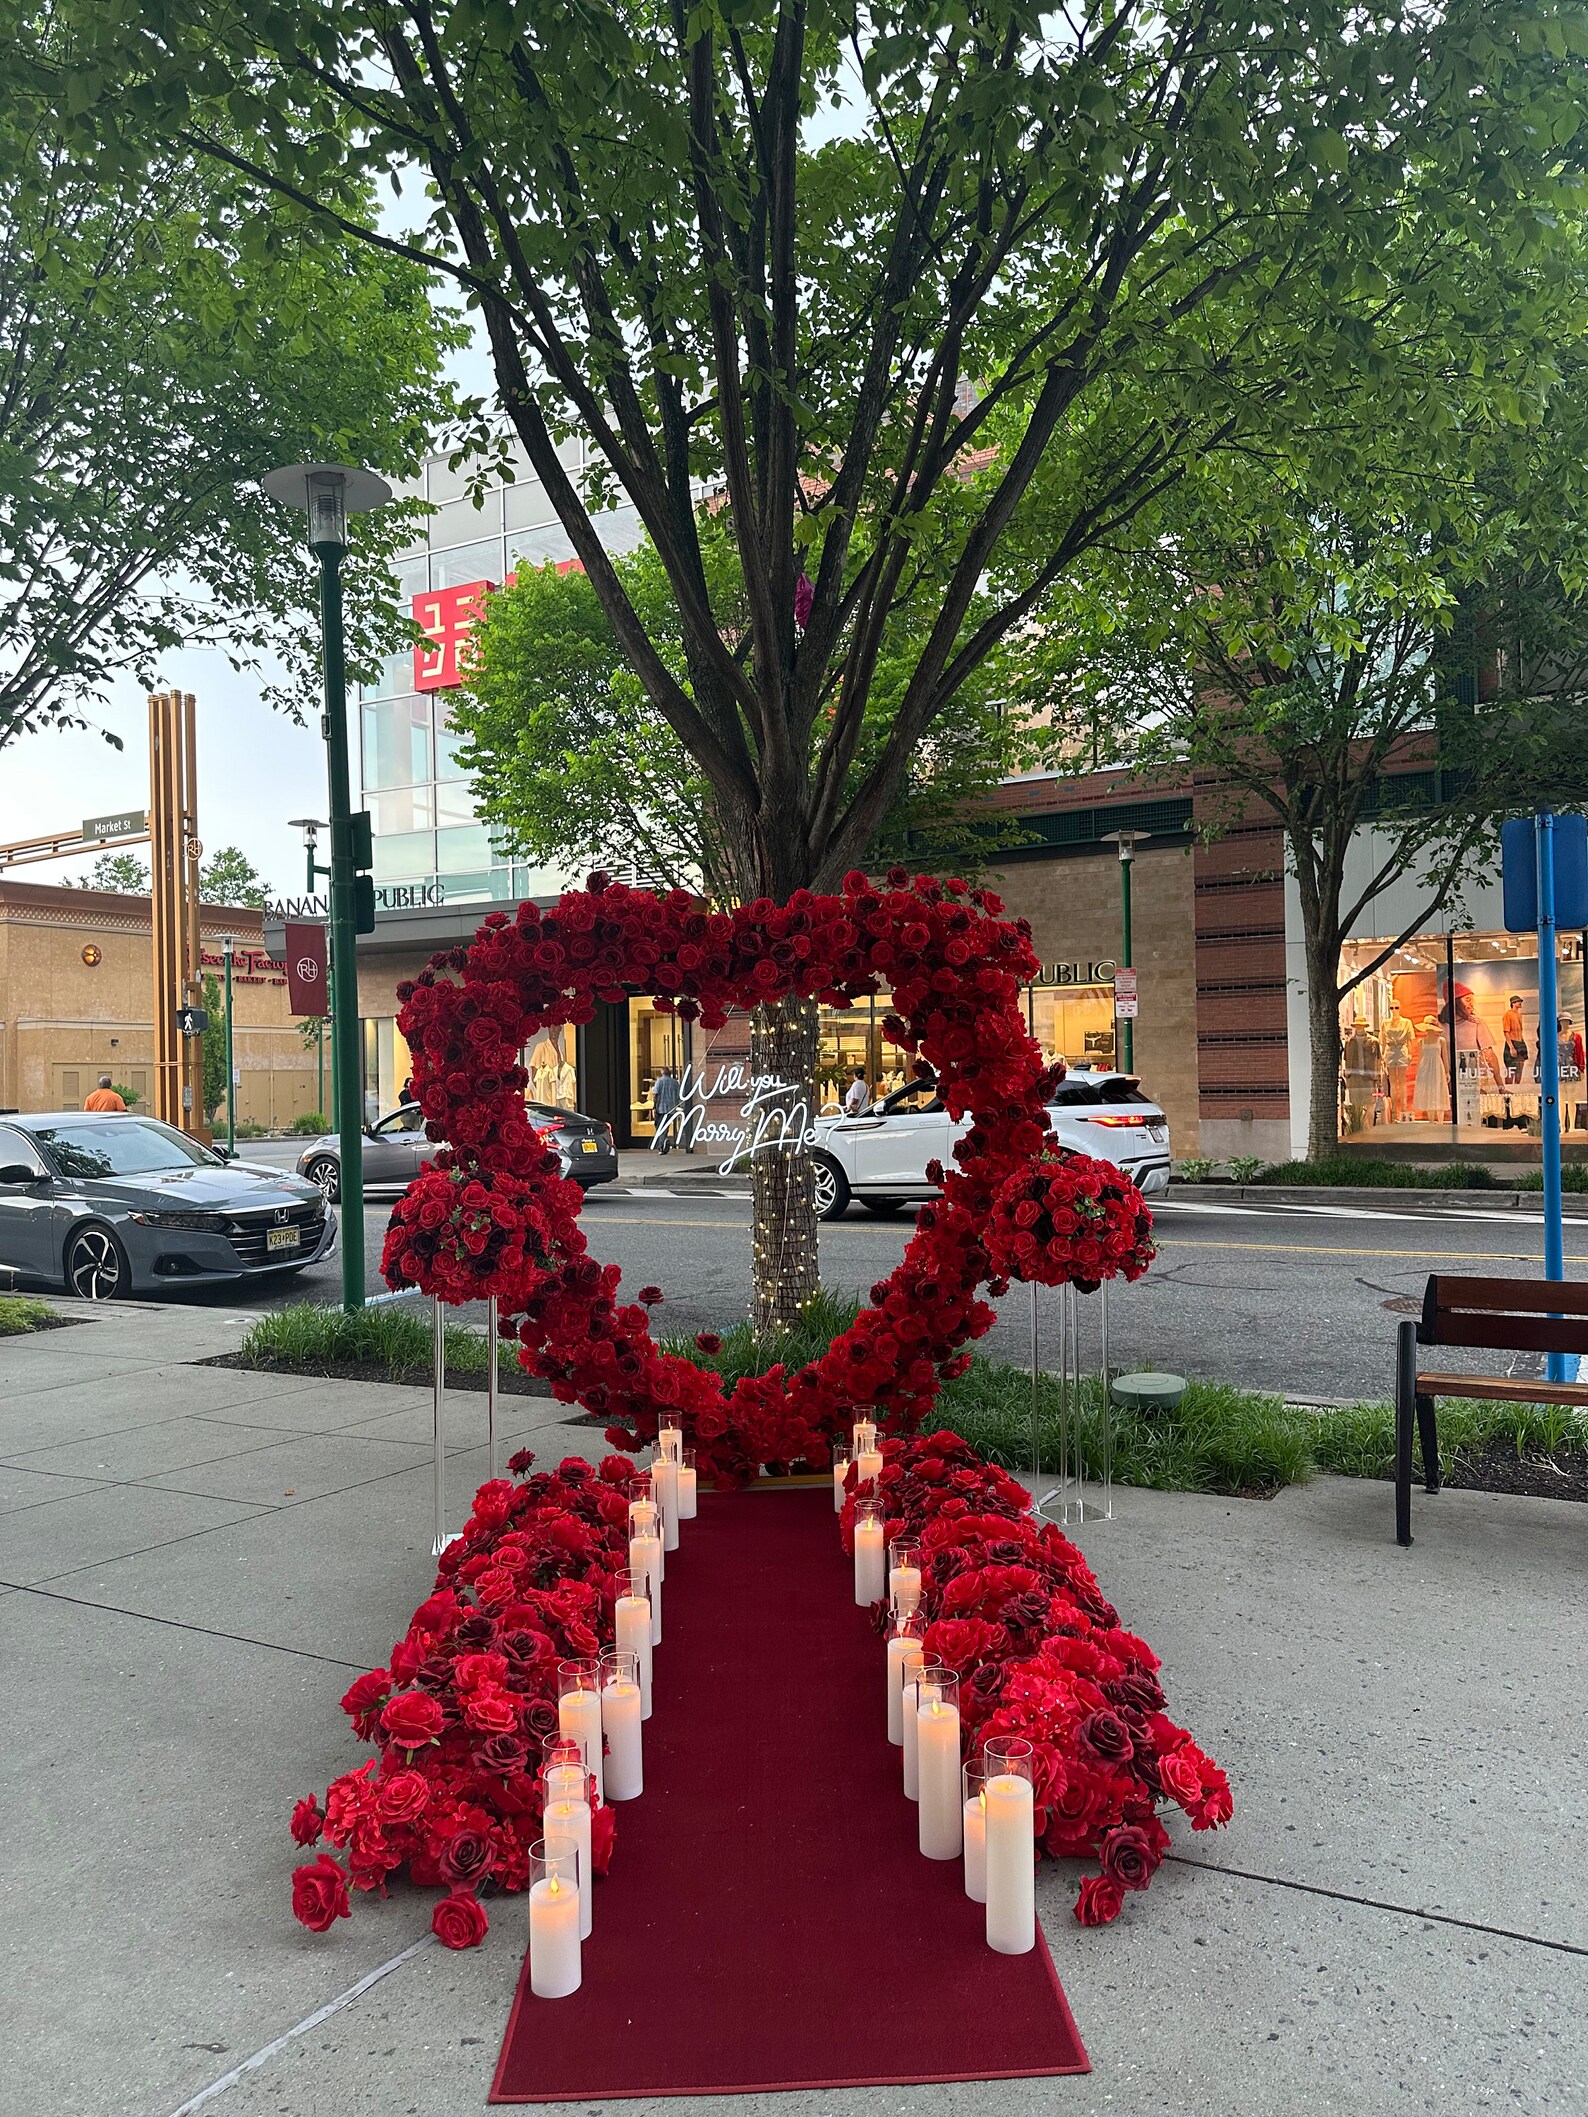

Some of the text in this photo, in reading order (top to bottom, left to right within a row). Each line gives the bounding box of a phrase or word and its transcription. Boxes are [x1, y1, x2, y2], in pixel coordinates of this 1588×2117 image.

[94, 820, 132, 835] Market St
[264, 884, 445, 920] BANAN PUBLIC
[679, 1064, 800, 1118] Will you
[651, 1104, 750, 1176] Marry
